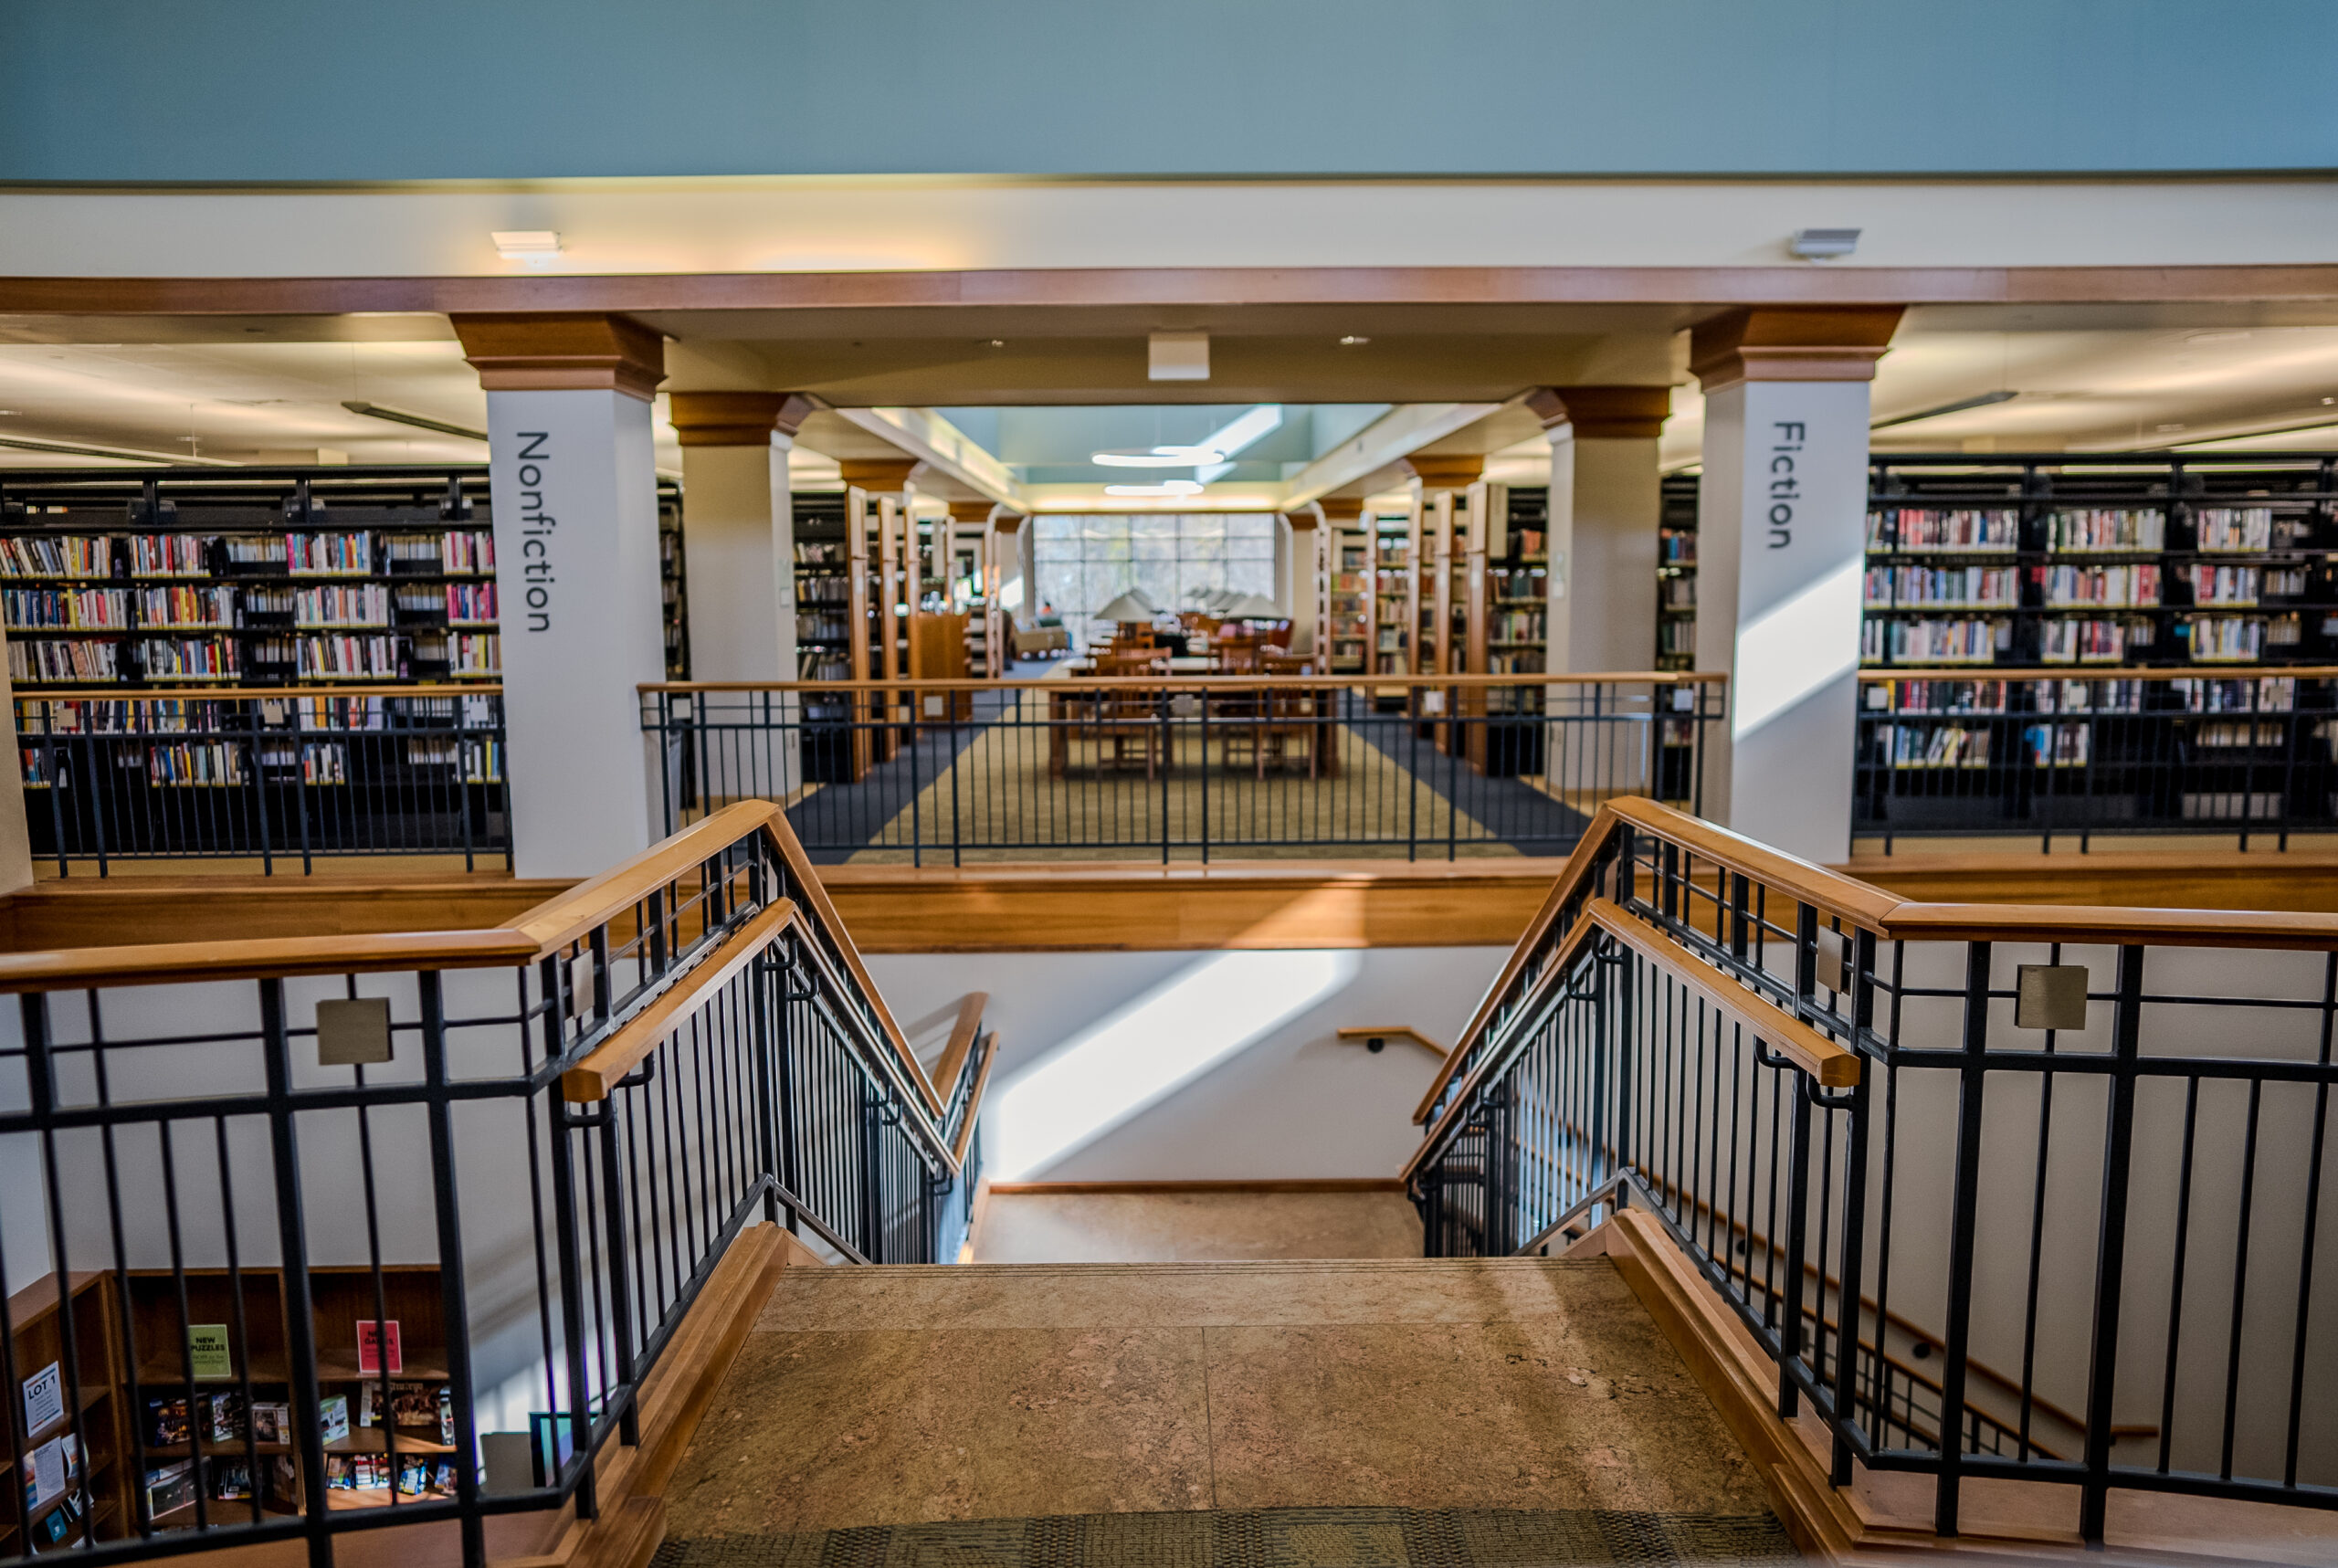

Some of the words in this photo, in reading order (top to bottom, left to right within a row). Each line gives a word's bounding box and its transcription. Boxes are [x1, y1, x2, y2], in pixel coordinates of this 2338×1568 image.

[1768, 421, 1805, 550] Fiction
[516, 431, 557, 633] Nonfiction
[190, 1343, 226, 1352] PUZZLES
[195, 1336, 216, 1344] NEW
[364, 1337, 395, 1345] GAS
[28, 1379, 48, 1401] LOT
[50, 1373, 57, 1384] 1
